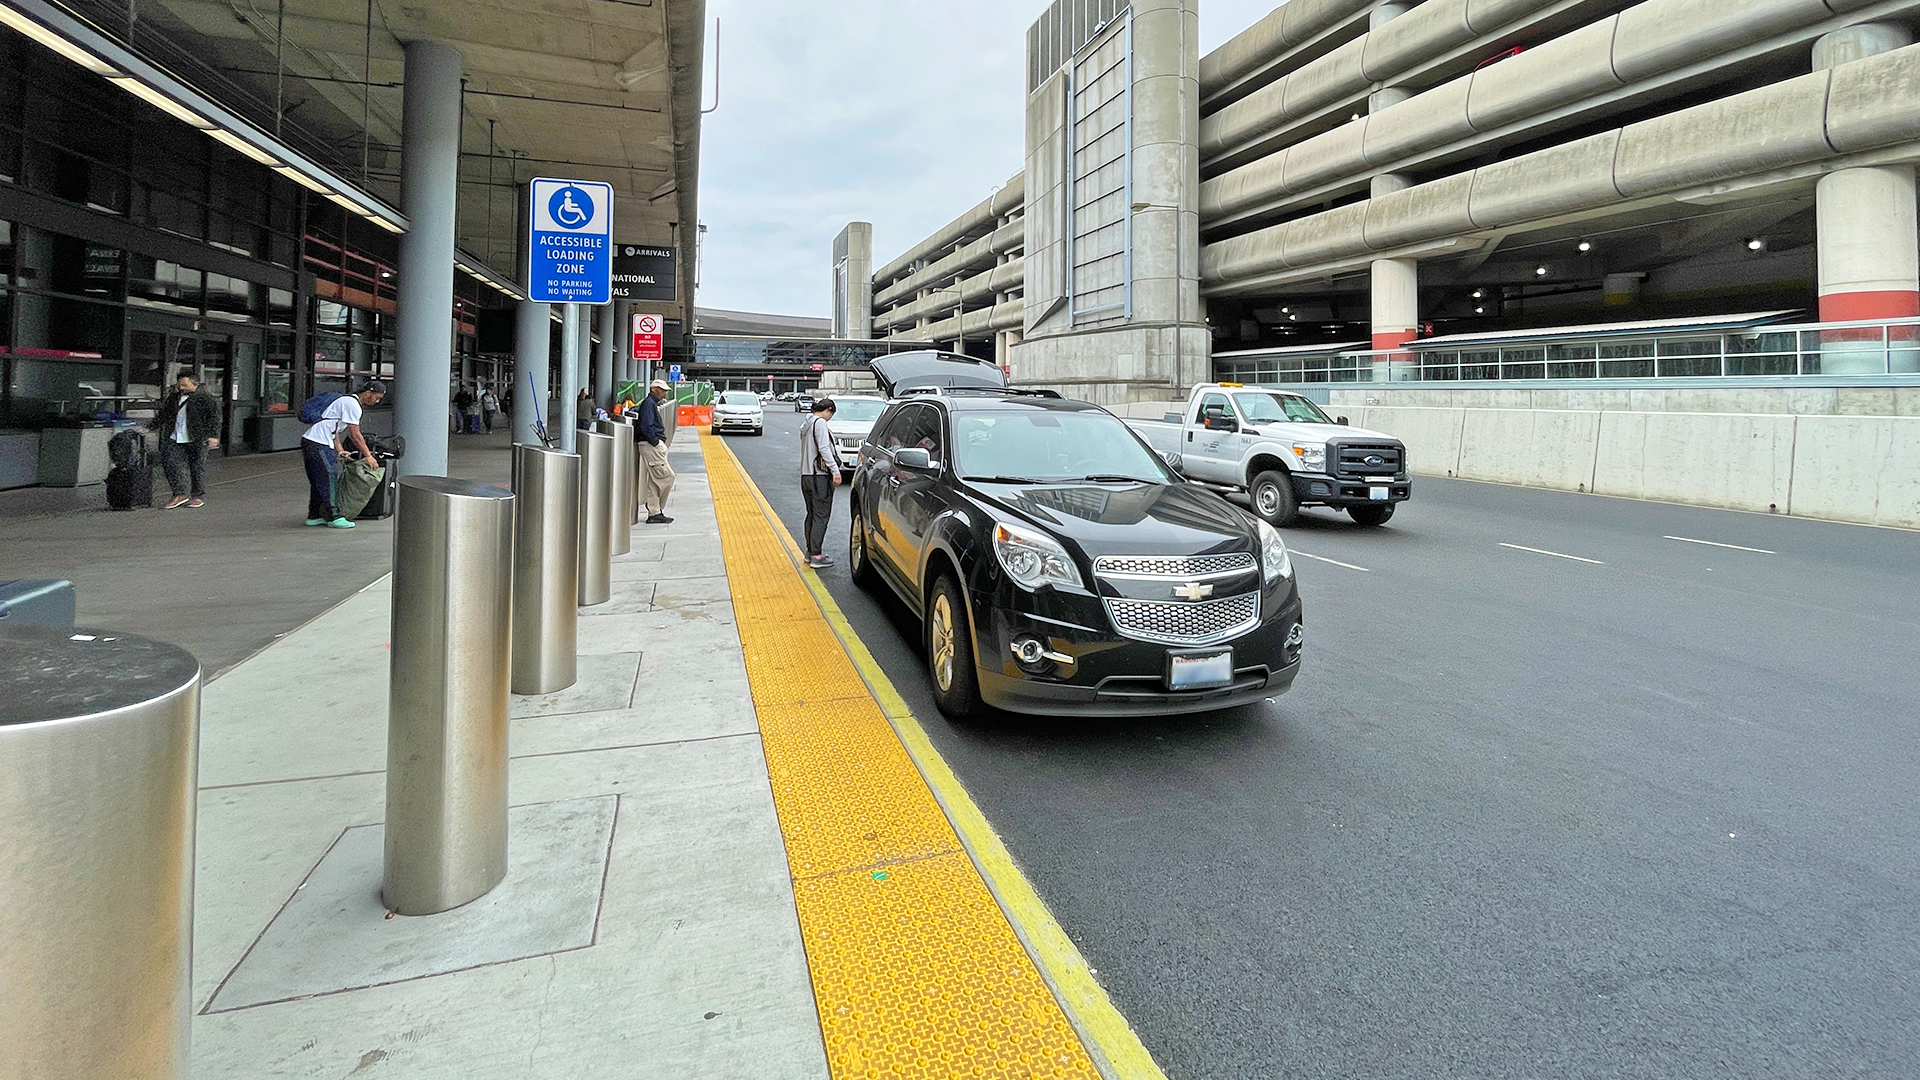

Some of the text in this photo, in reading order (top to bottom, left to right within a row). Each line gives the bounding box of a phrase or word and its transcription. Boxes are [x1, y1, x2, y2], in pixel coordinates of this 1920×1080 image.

[540, 235, 602, 248] ACCESSIBLE
[547, 249, 595, 261] LOADING
[636, 249, 671, 258] ARRIVALS
[556, 263, 585, 274] ZONE
[547, 279, 593, 288] NO PARKING
